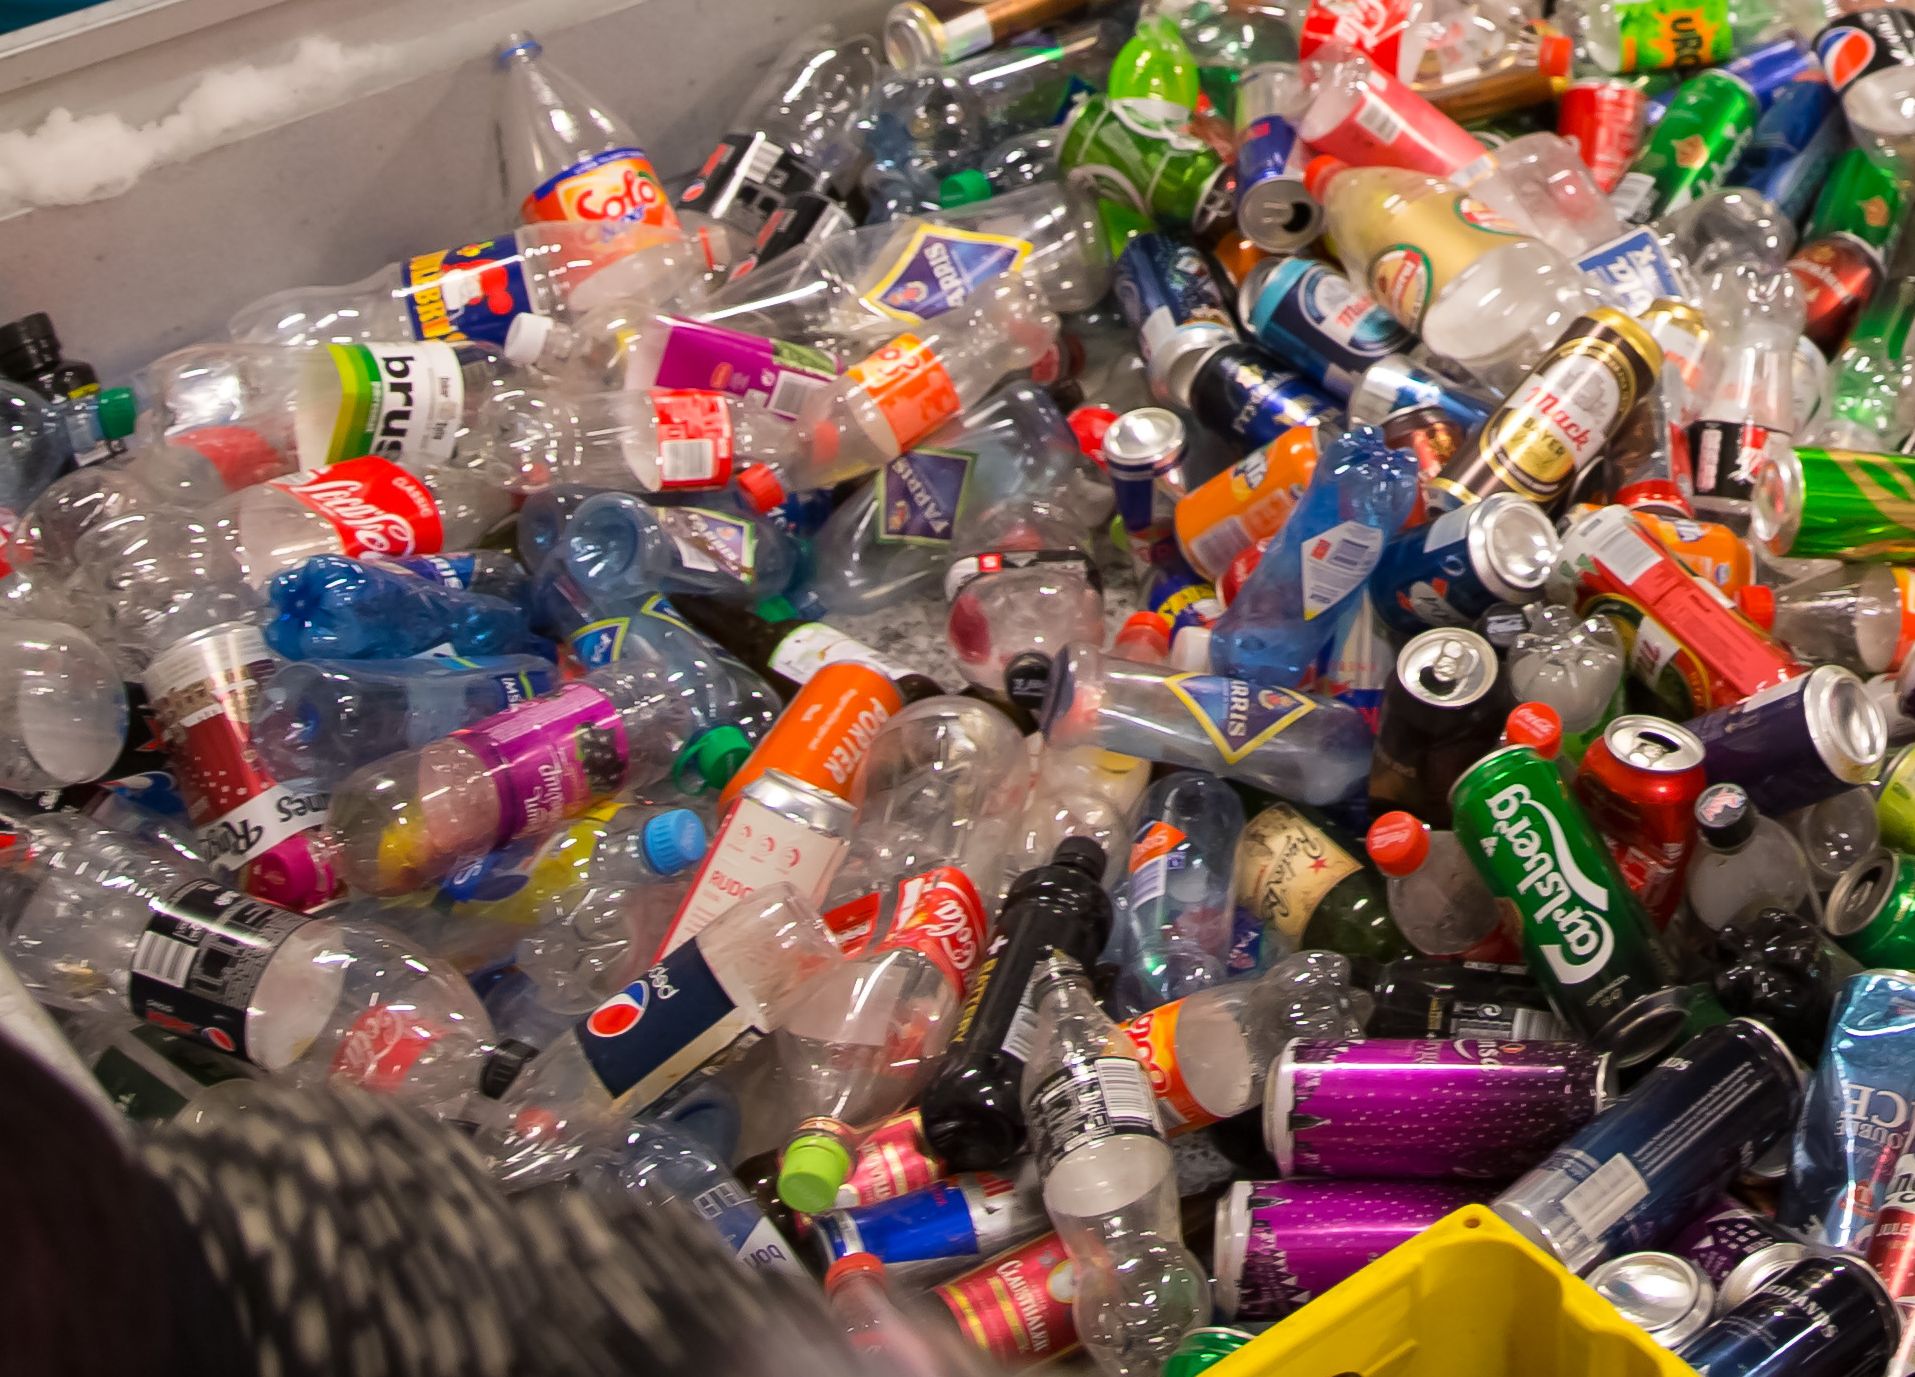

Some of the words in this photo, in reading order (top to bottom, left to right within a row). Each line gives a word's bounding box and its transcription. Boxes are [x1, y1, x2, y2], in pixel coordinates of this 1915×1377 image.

[924, 242, 966, 307] ARRIS
[1522, 415, 1567, 457] BYER
[1226, 679, 1250, 738] RRIS
[822, 697, 891, 785] PORTER
[1485, 784, 1615, 985] Carlsberg
[1833, 1119, 1906, 1151] OUBLE
